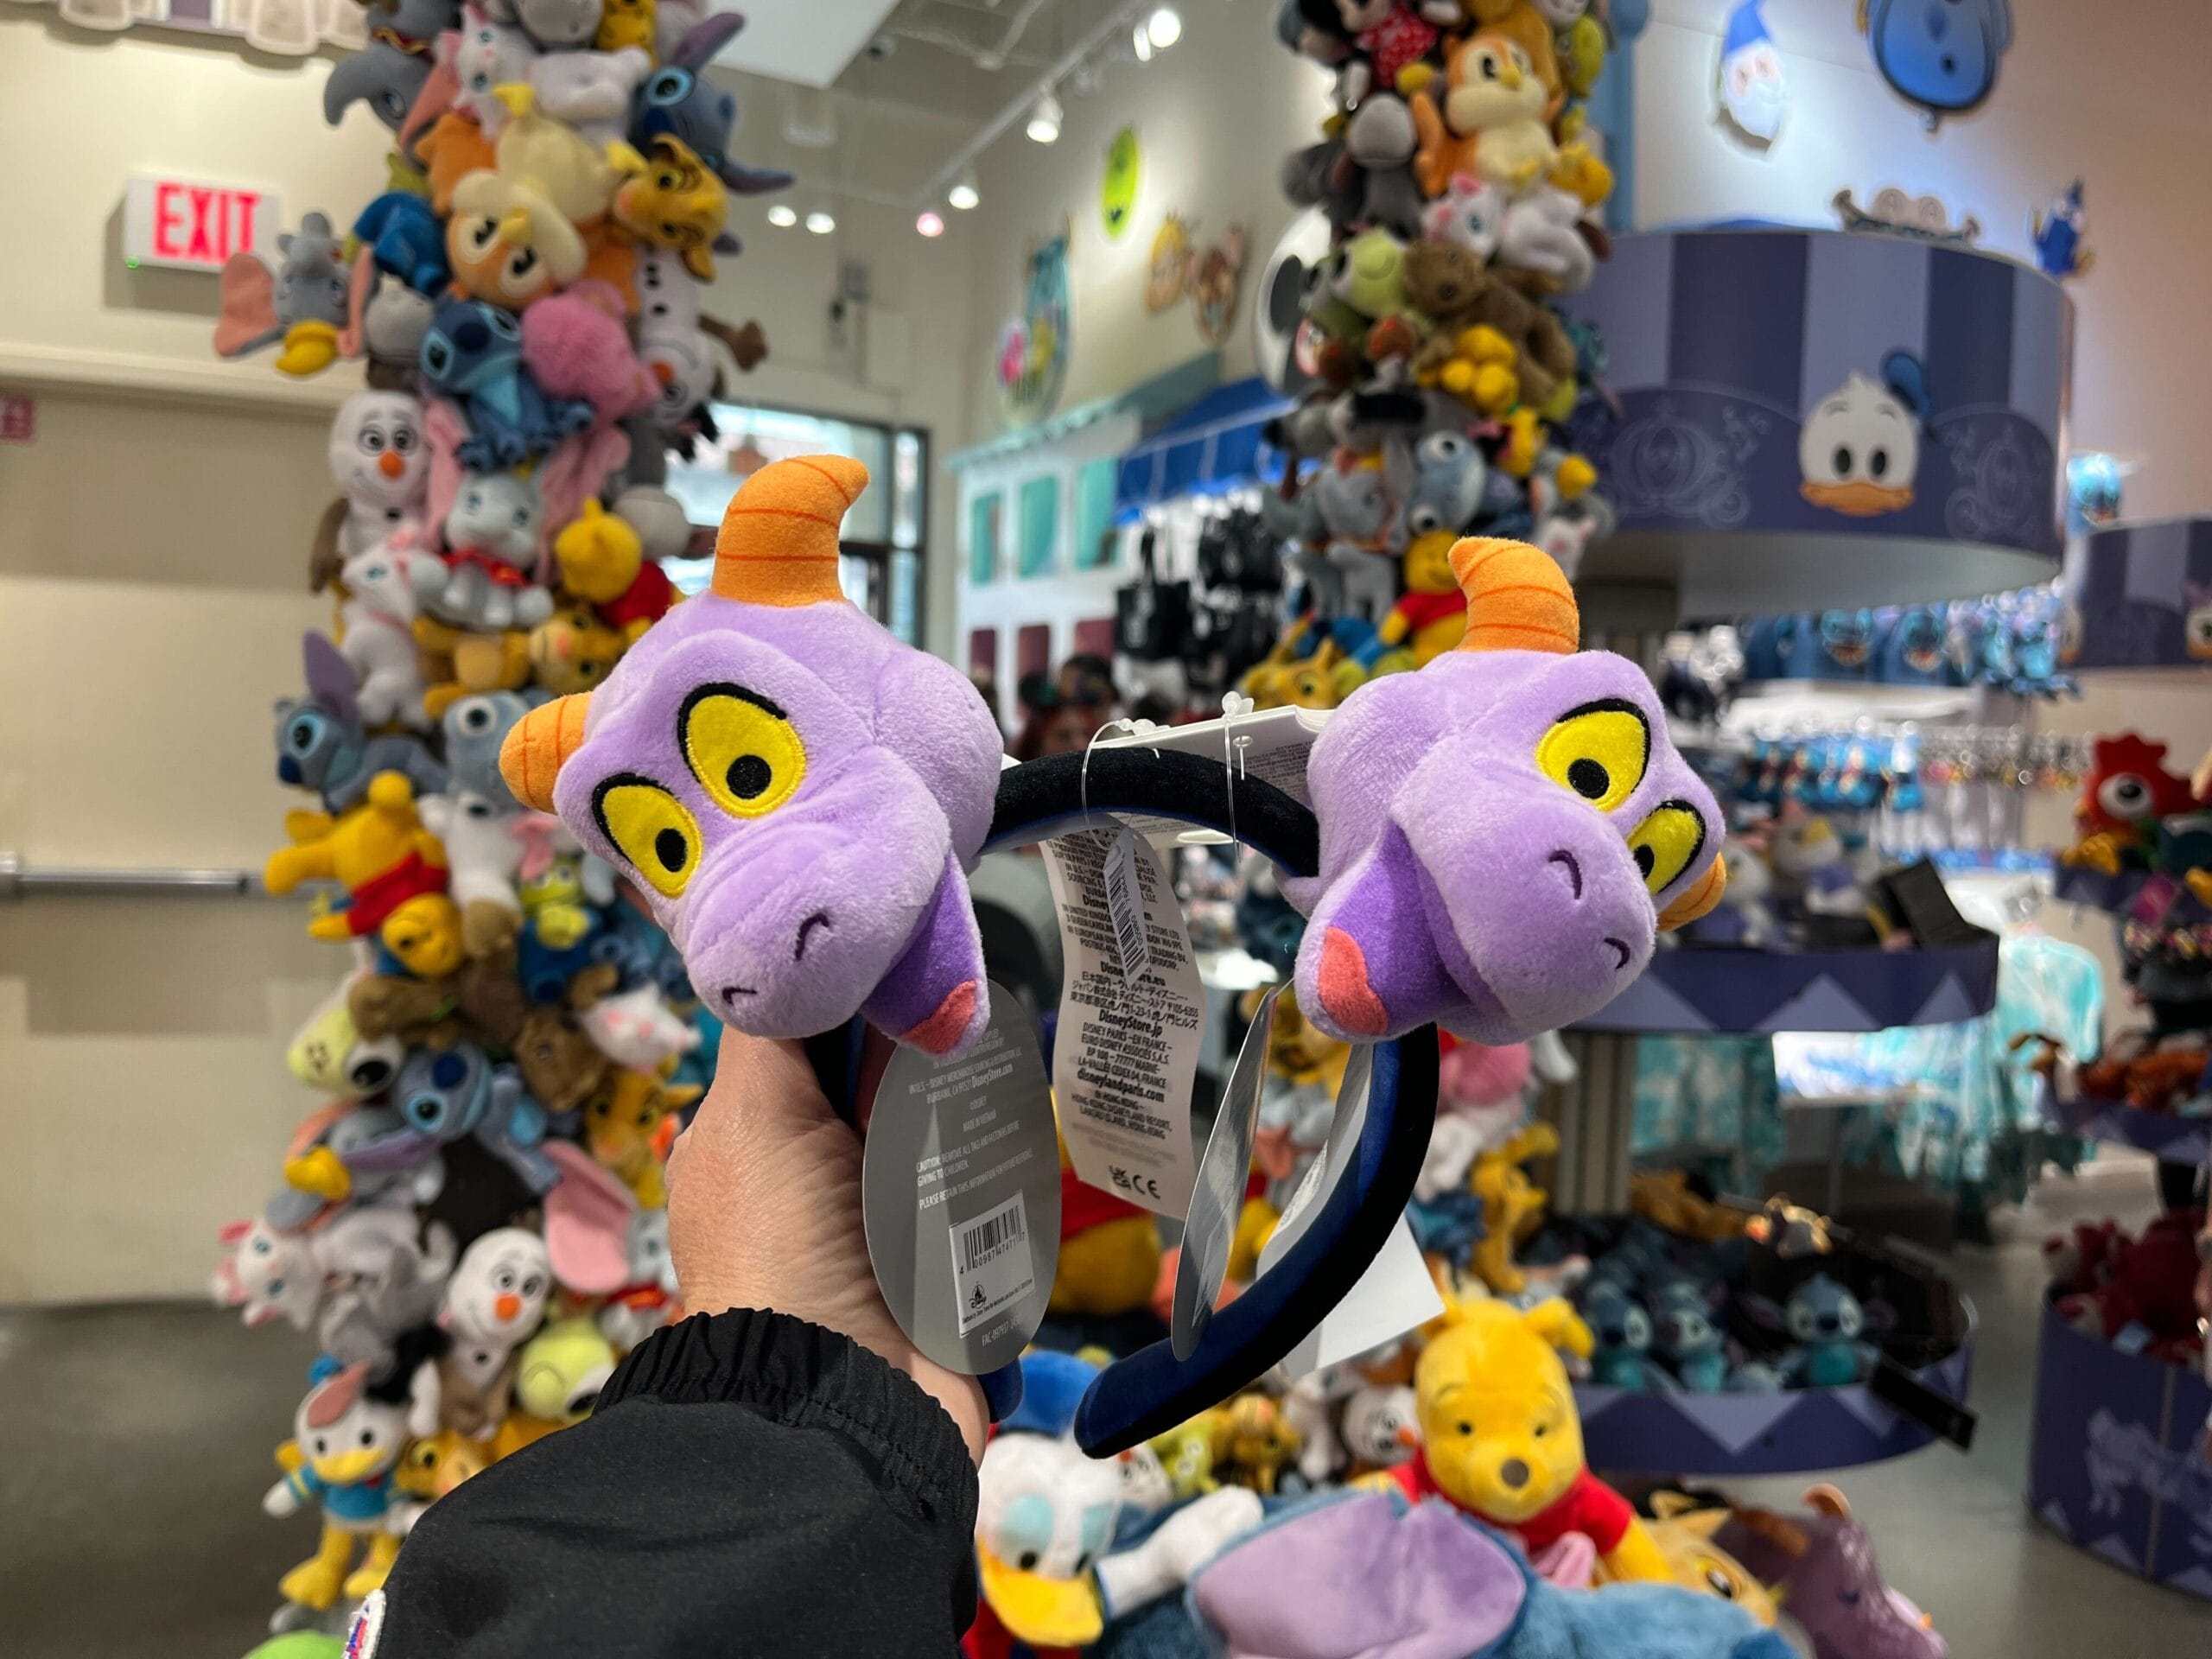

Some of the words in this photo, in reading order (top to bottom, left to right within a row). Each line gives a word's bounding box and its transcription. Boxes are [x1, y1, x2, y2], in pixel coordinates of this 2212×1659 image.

[153, 181, 262, 264] EXIT
[1083, 1022, 1106, 1036] DISNEY
[1106, 1028, 1128, 1042] PARKS
[1142, 1037, 1166, 1052] FRANCE
[1099, 1009, 1162, 1039] DisneyStore.jp
[1081, 1033, 1099, 1046] EURO
[1099, 1037, 1122, 1052] DISNEY
[1153, 1051, 1169, 1065] S.A.S.
[1087, 1047, 1096, 1056] BP
[971, 1064, 1014, 1089] DisneyStore.com
[1077, 1067, 1165, 1103] disneylandparis.com
[1141, 1072, 1166, 1087] FRANCE
[1103, 1092, 1121, 1103] HONG
[1121, 1097, 1139, 1110] KONG
[942, 1147, 962, 1163] REMOVE
[962, 1144, 970, 1155] ALL
[918, 1169, 937, 1187] GIVING
[937, 1167, 944, 1179] TO
[919, 1192, 939, 1210] PLEASE
[939, 1185, 957, 1202] RETAIN
[957, 1180, 969, 1193] THIS
